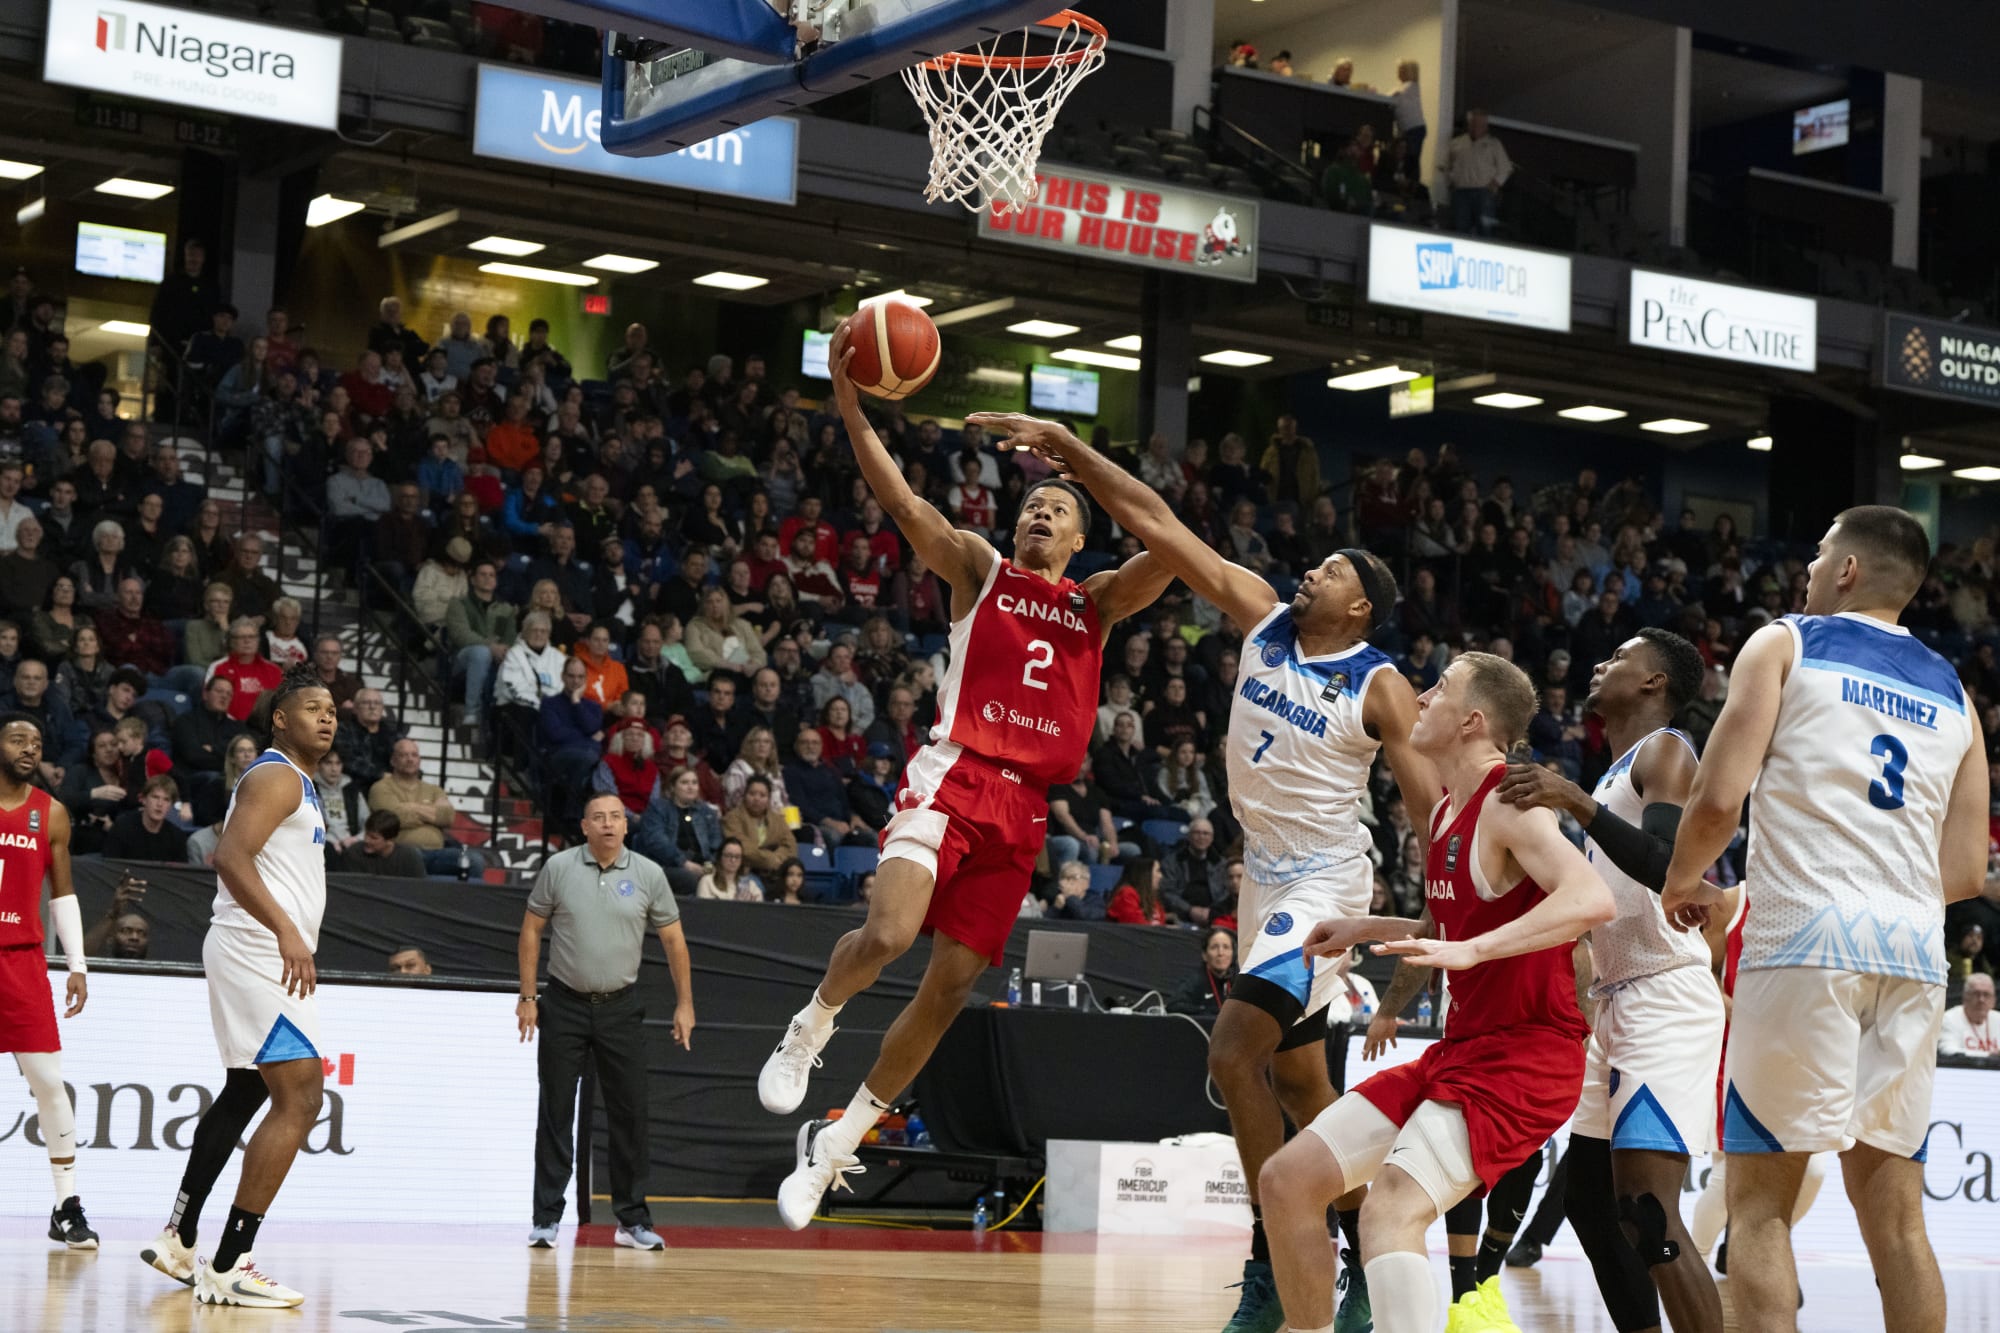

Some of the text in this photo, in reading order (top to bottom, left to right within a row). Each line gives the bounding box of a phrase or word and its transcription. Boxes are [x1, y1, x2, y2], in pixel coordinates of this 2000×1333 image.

[136, 22, 294, 79] Niagara
[222, 82, 278, 107] DOORS
[1122, 189, 1162, 224] IS
[989, 201, 1198, 264] OUR HOUSE
[1669, 284, 1698, 307] the
[1939, 359, 2000, 385] OUTD
[996, 594, 1088, 634] CANADA
[1022, 639, 1054, 690] 2
[1842, 677, 1938, 731] MARTINEZ
[1007, 710, 1061, 736] Sun Life
[1252, 730, 1274, 763] 7
[1001, 768, 1022, 784] CAN
[1868, 734, 1908, 810] 3
[1, 911, 21, 924] Life
[1135, 1166, 1152, 1177] FIBA
[1222, 1169, 1239, 1180] FIBA
[1117, 1178, 1168, 1193] AMERICUP
[1205, 1180, 1250, 1195] AMERICU
